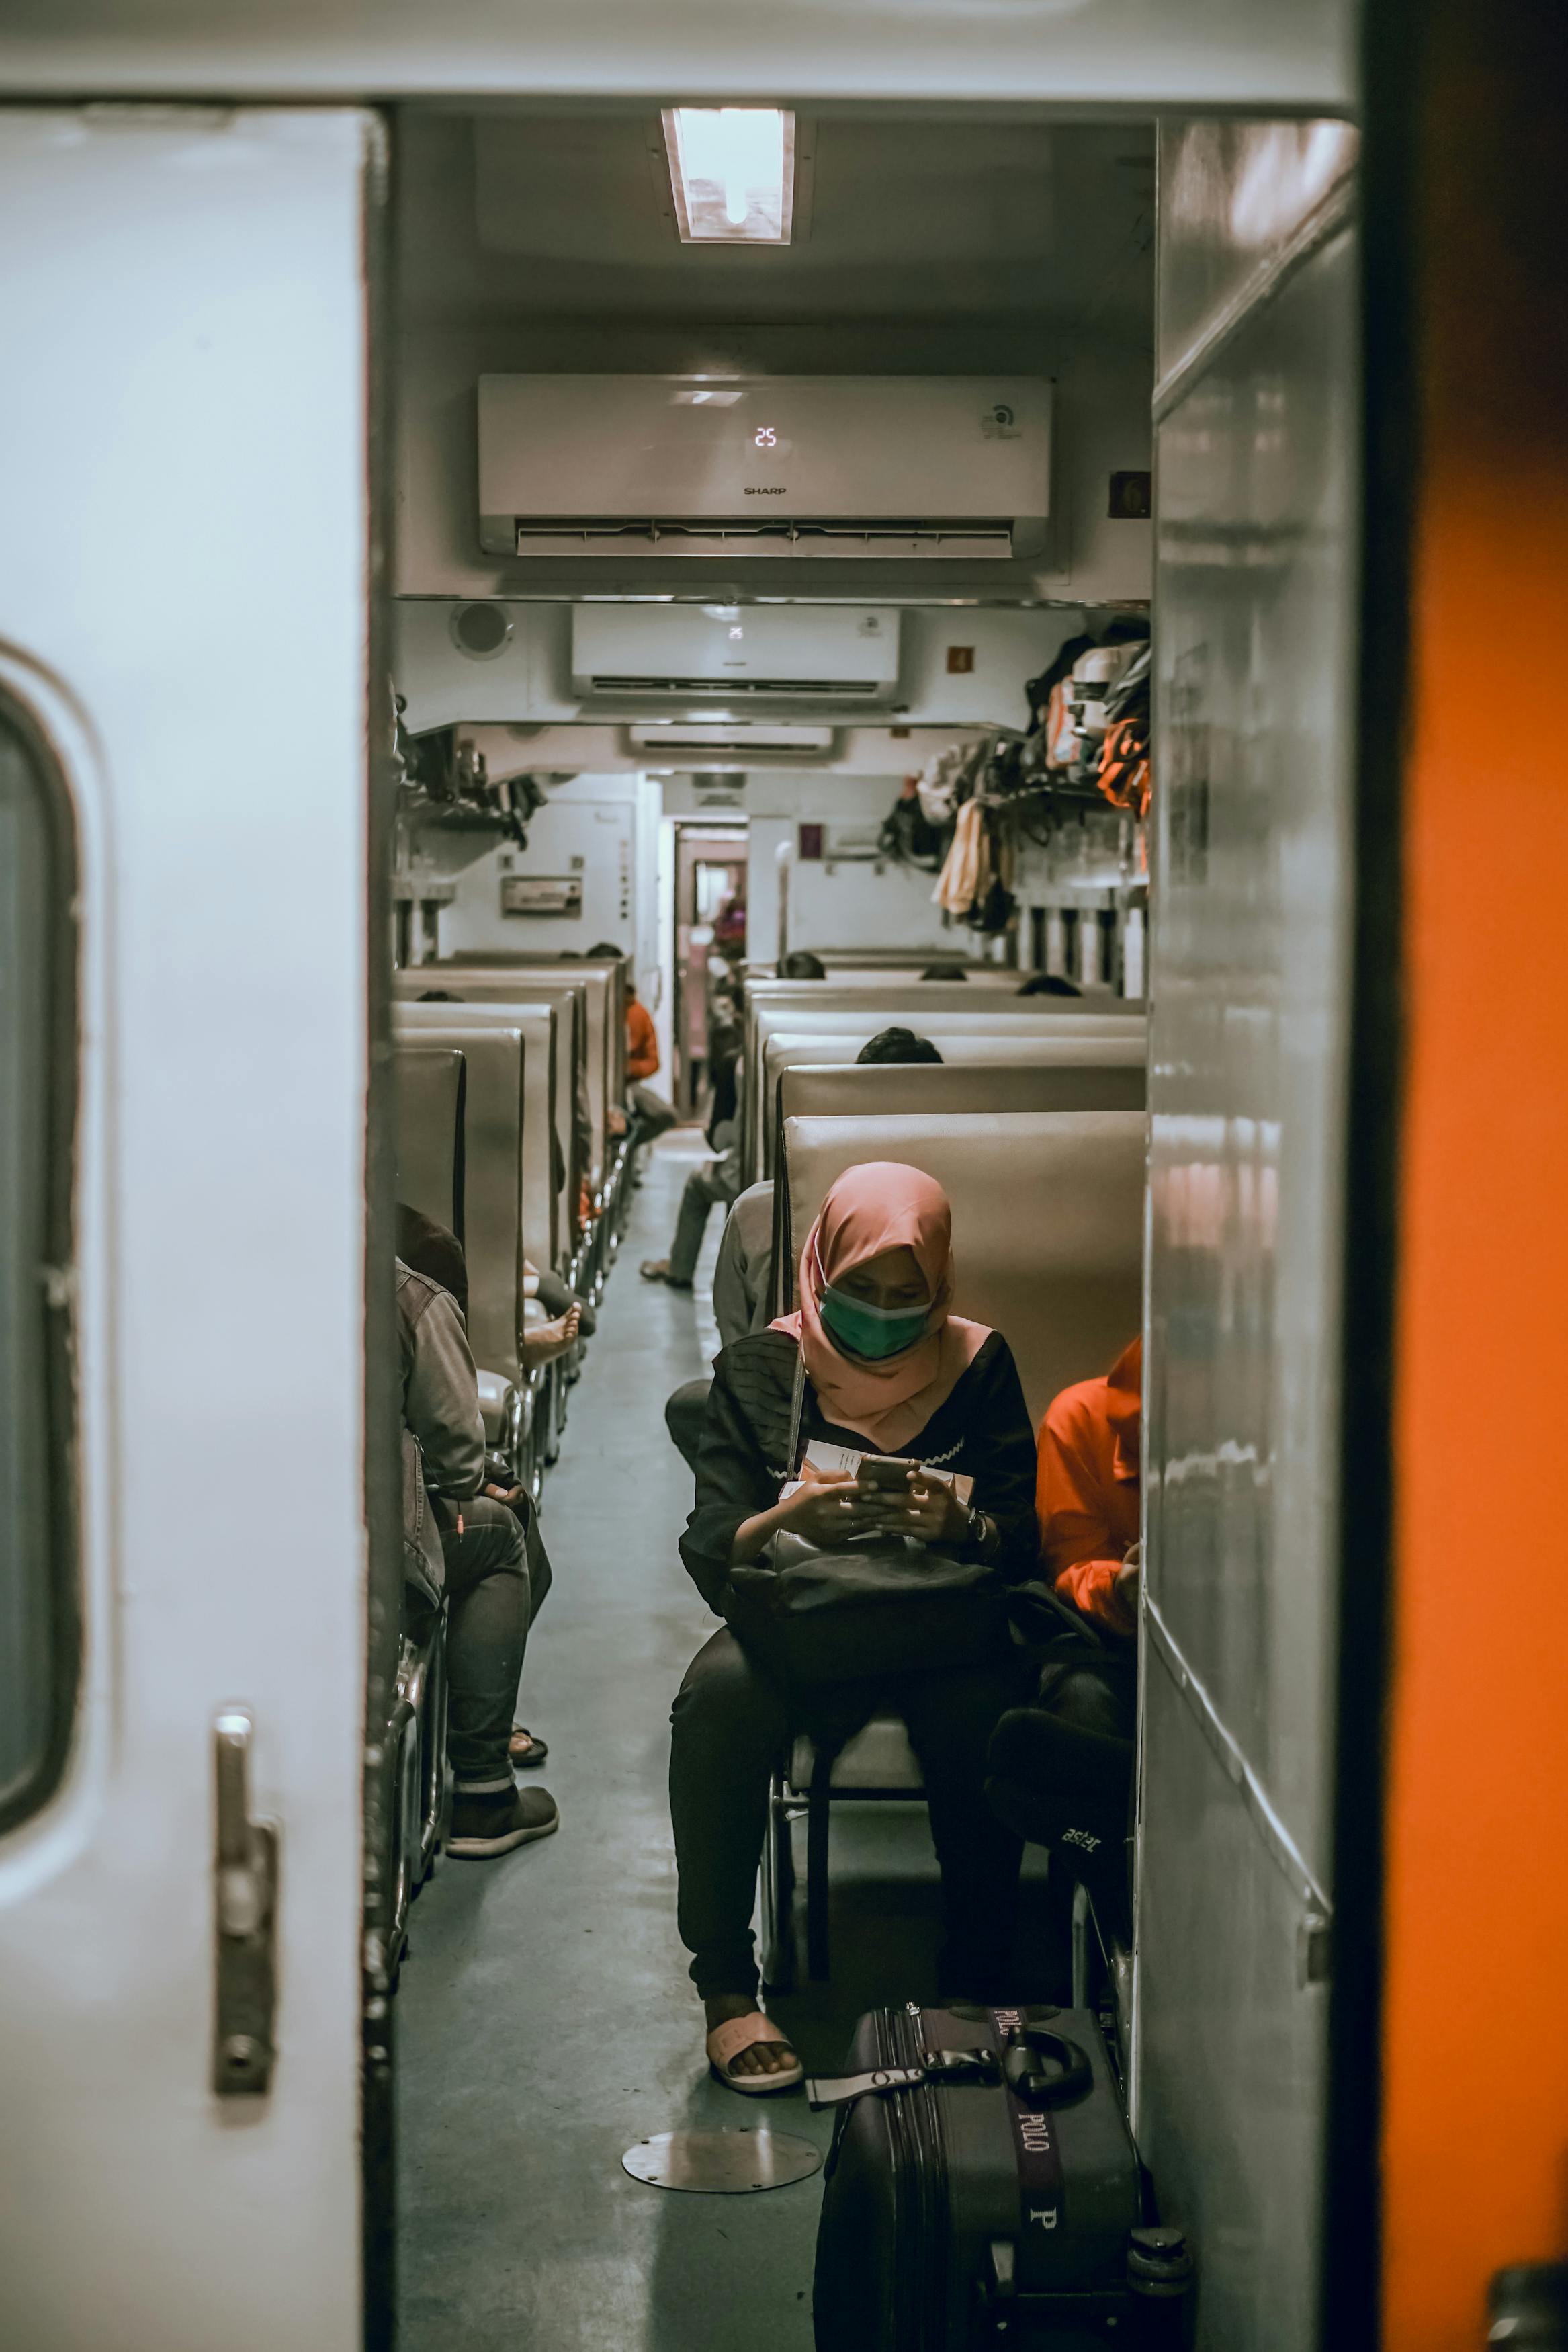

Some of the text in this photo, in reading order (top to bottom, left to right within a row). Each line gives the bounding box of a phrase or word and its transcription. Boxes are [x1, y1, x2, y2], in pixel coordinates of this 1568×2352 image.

[755, 427, 777, 447] 25
[744, 487, 787, 495] SHARP
[1018, 2113, 1050, 2151] POLO
[1030, 2206, 1057, 2229] P
